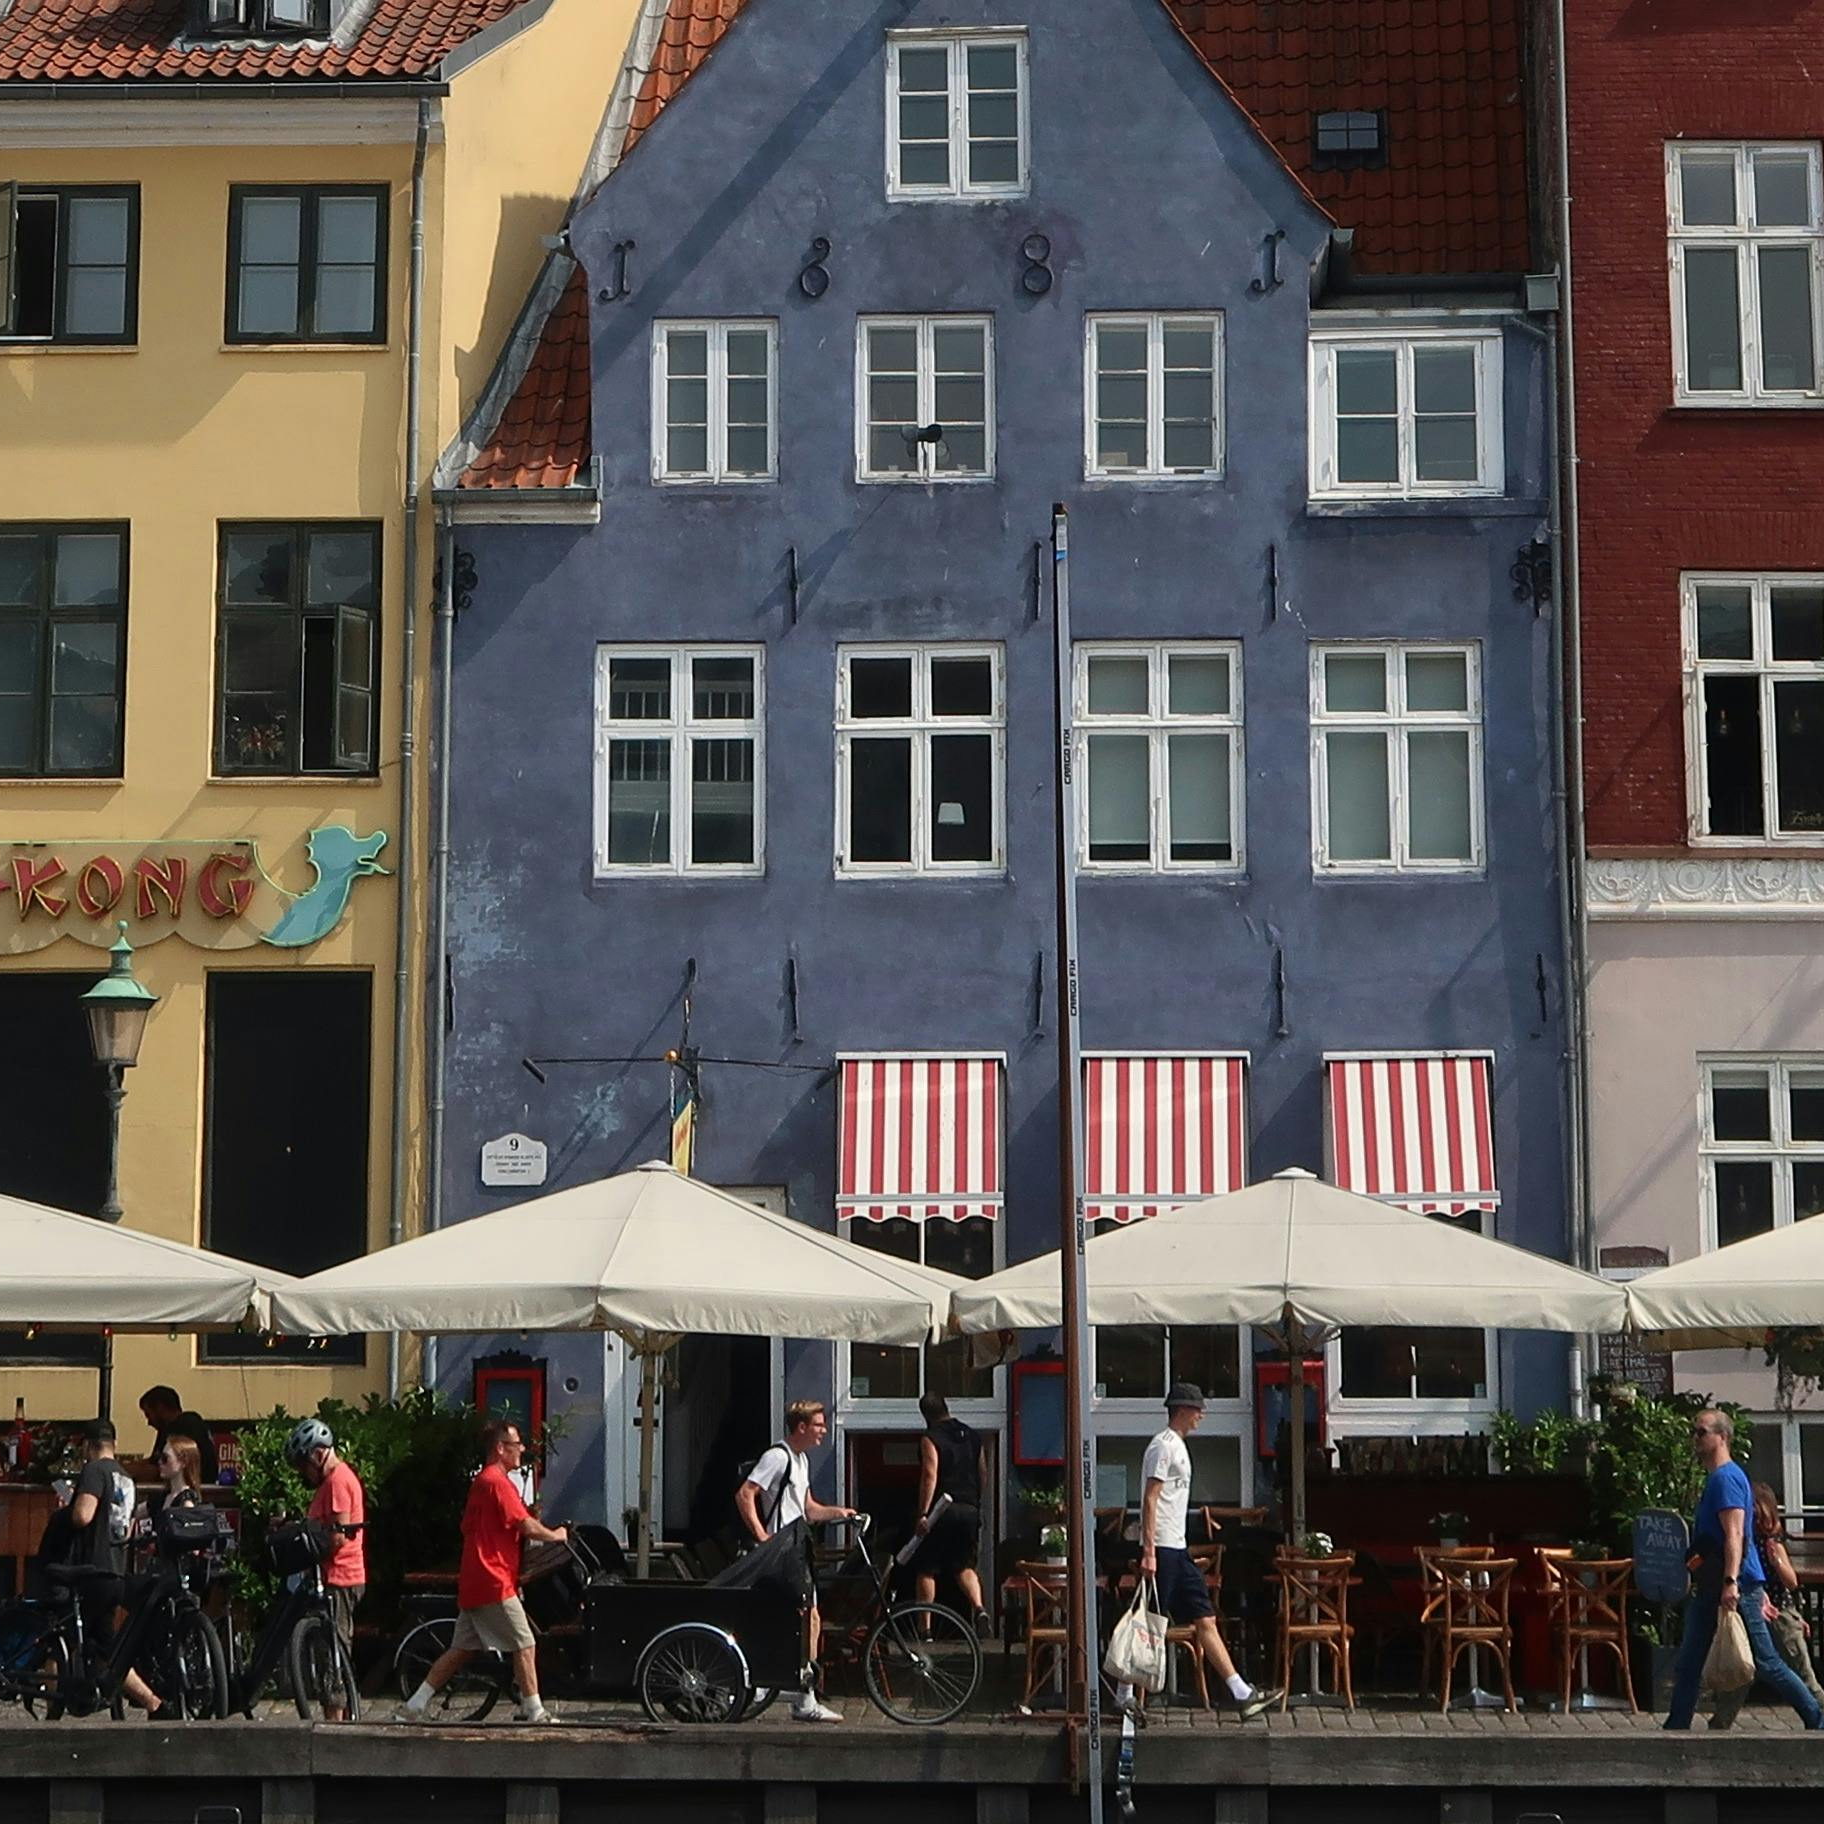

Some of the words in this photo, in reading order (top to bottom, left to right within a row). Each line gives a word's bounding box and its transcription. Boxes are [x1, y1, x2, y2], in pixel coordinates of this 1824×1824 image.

[1063, 728, 1071, 746] FIX
[1063, 749, 1071, 785] CARGO
[1069, 979, 1077, 1017] CARGO
[509, 1137, 520, 1152] 9
[1076, 1218, 1084, 1255] CARGO
[1083, 1461, 1091, 1500] CARGO
[1639, 1515, 1673, 1534] TAKE
[1646, 1532, 1682, 1552] AWAY
[1090, 1711, 1099, 1750] CARGO
